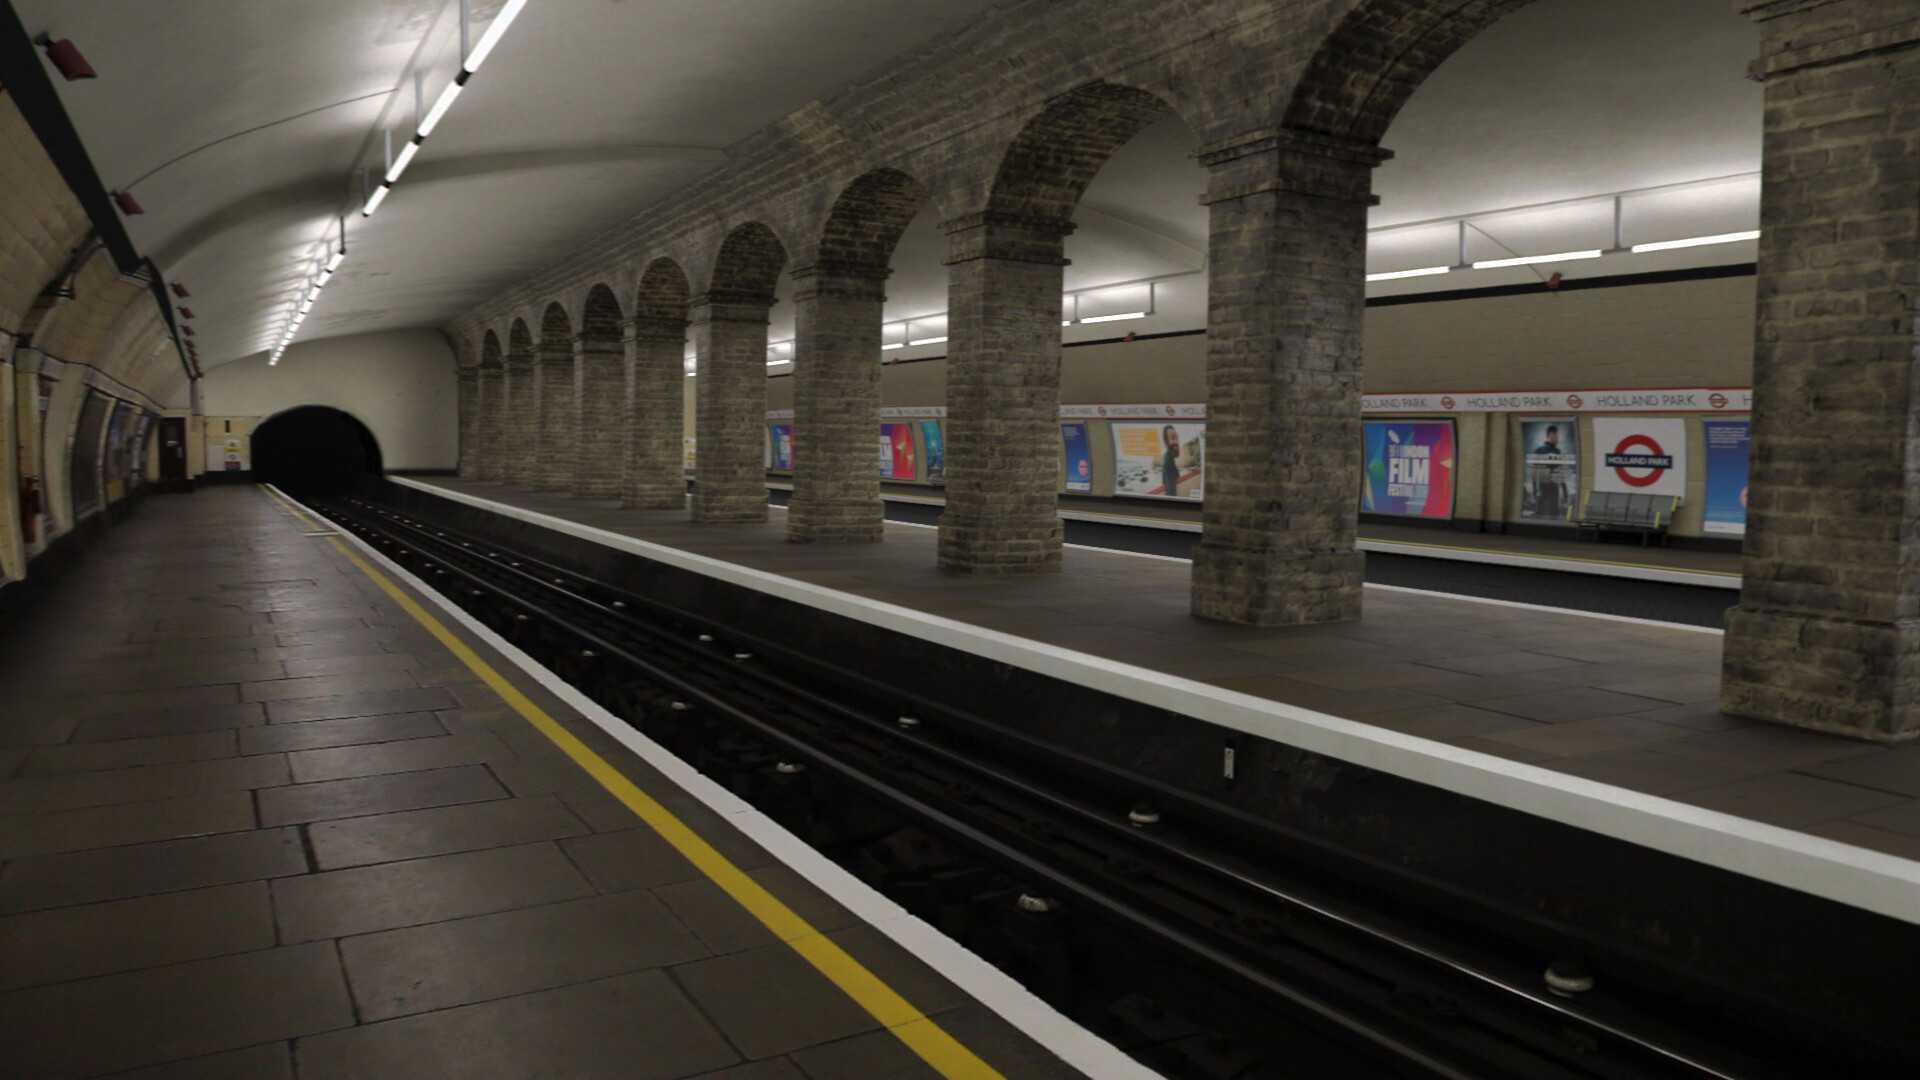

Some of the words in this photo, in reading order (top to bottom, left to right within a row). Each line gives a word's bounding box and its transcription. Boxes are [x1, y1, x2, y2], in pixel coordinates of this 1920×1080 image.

[1363, 398, 1400, 408] OLLAND
[1402, 398, 1428, 407] PARK
[1467, 397, 1521, 408] HOLLAND
[1523, 396, 1552, 407] PARK
[1597, 395, 1659, 407] HOLLAND
[1662, 394, 1697, 406] PARK
[1607, 456, 1647, 466] HOLLAND
[1648, 457, 1669, 466] PARK
[1389, 457, 1430, 485] FILM
